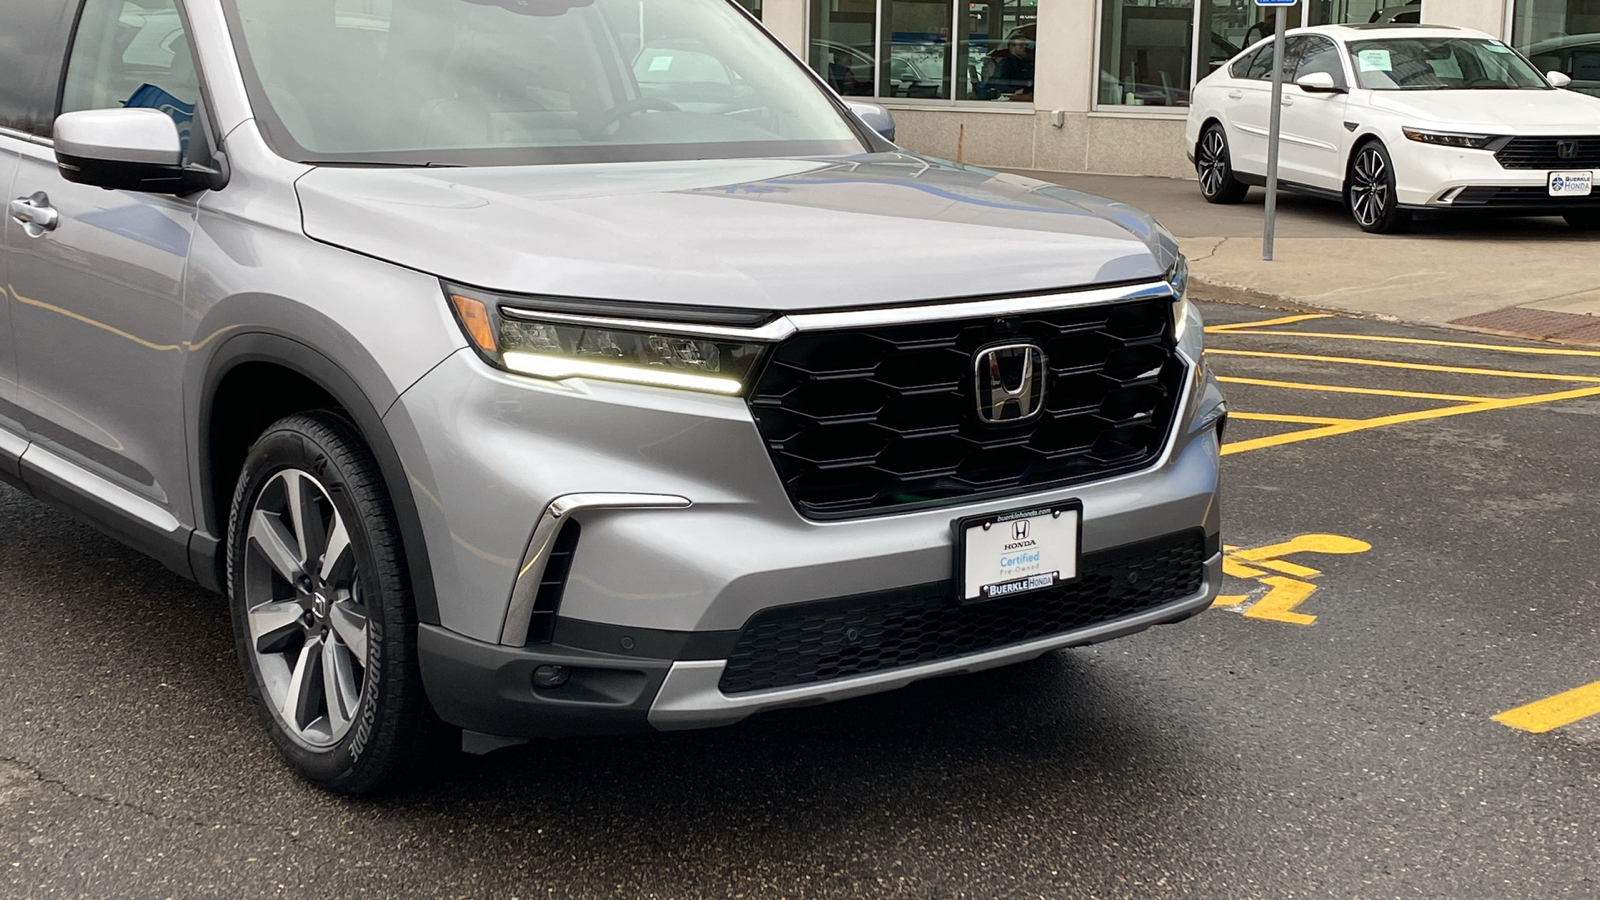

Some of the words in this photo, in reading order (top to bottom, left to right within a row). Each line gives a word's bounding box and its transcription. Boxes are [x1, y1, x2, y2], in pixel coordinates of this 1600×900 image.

[997, 508, 1051, 522] buerklehonda.com
[1004, 539, 1036, 550] HONDA
[1000, 551, 1039, 567] Certified
[1000, 563, 1039, 575] Pre-Owned
[989, 580, 1028, 595] BUERKLE
[1028, 576, 1052, 589] HONDA
[348, 618, 383, 763] BRIDGESTONE
